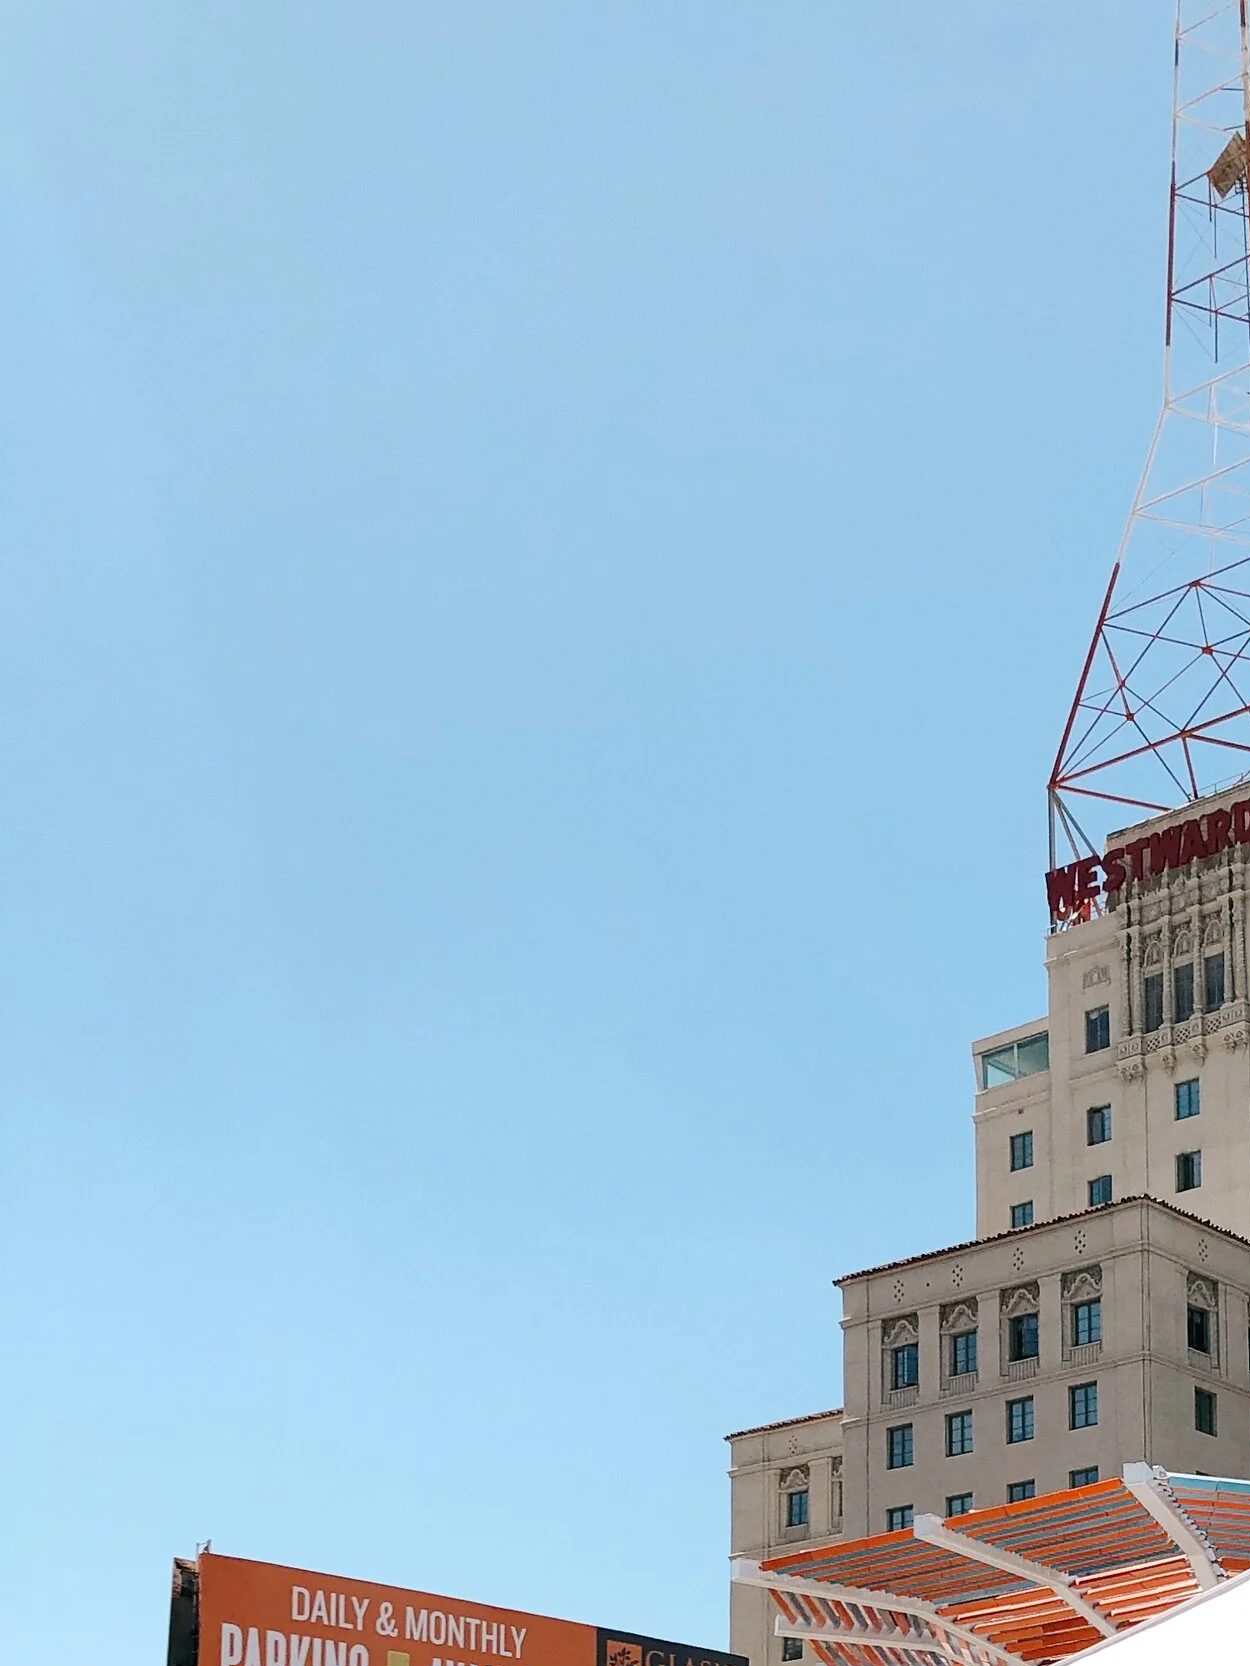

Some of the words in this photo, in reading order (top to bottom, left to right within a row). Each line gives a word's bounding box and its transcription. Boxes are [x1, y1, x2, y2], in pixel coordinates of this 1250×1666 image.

[291, 1585, 371, 1631] DAILY
[375, 1601, 398, 1638] &
[404, 1606, 527, 1659] MONTHLY
